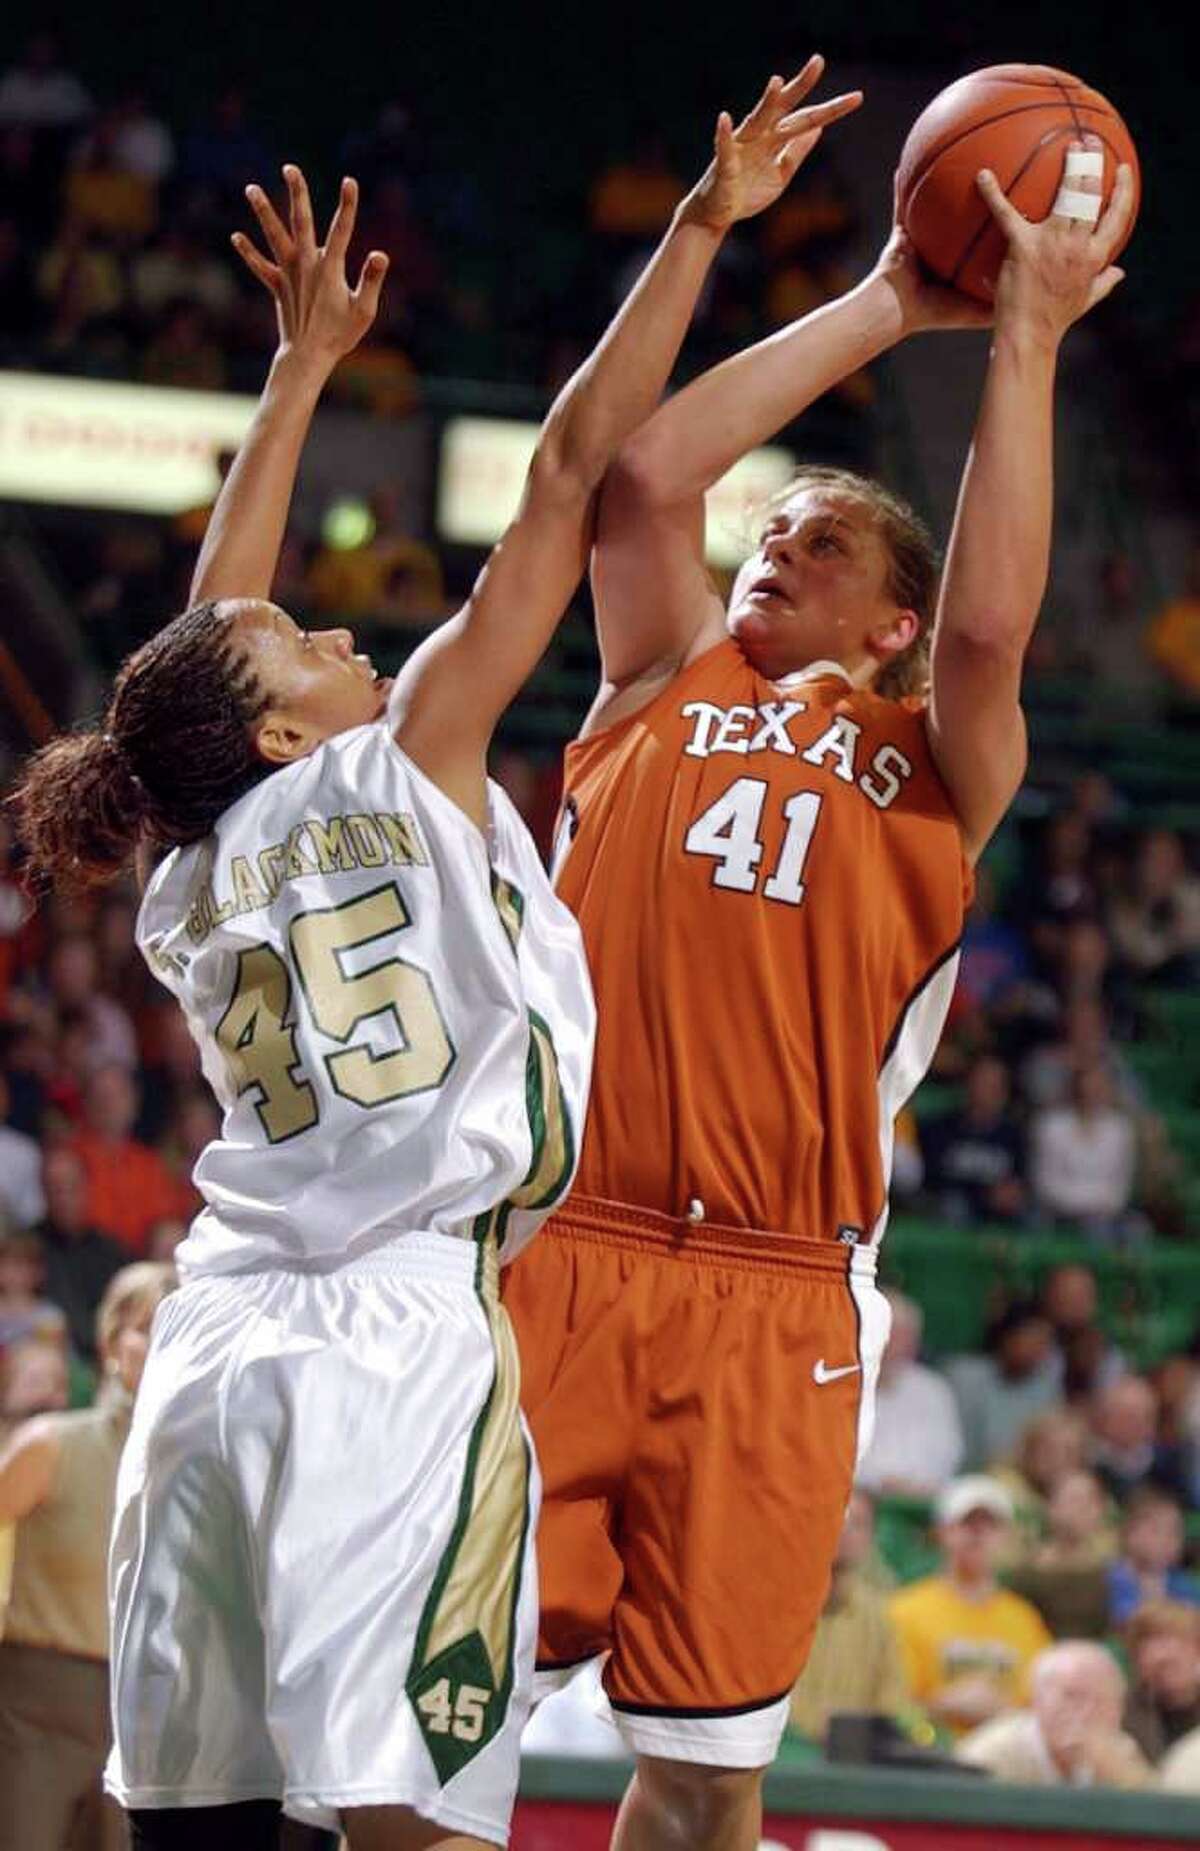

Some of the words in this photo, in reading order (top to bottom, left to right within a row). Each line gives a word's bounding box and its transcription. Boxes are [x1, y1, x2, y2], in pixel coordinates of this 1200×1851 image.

[681, 700, 912, 809] TEXAS
[684, 776, 823, 906] 41
[215, 880, 458, 1144] 45
[416, 1677, 493, 1742] 45
